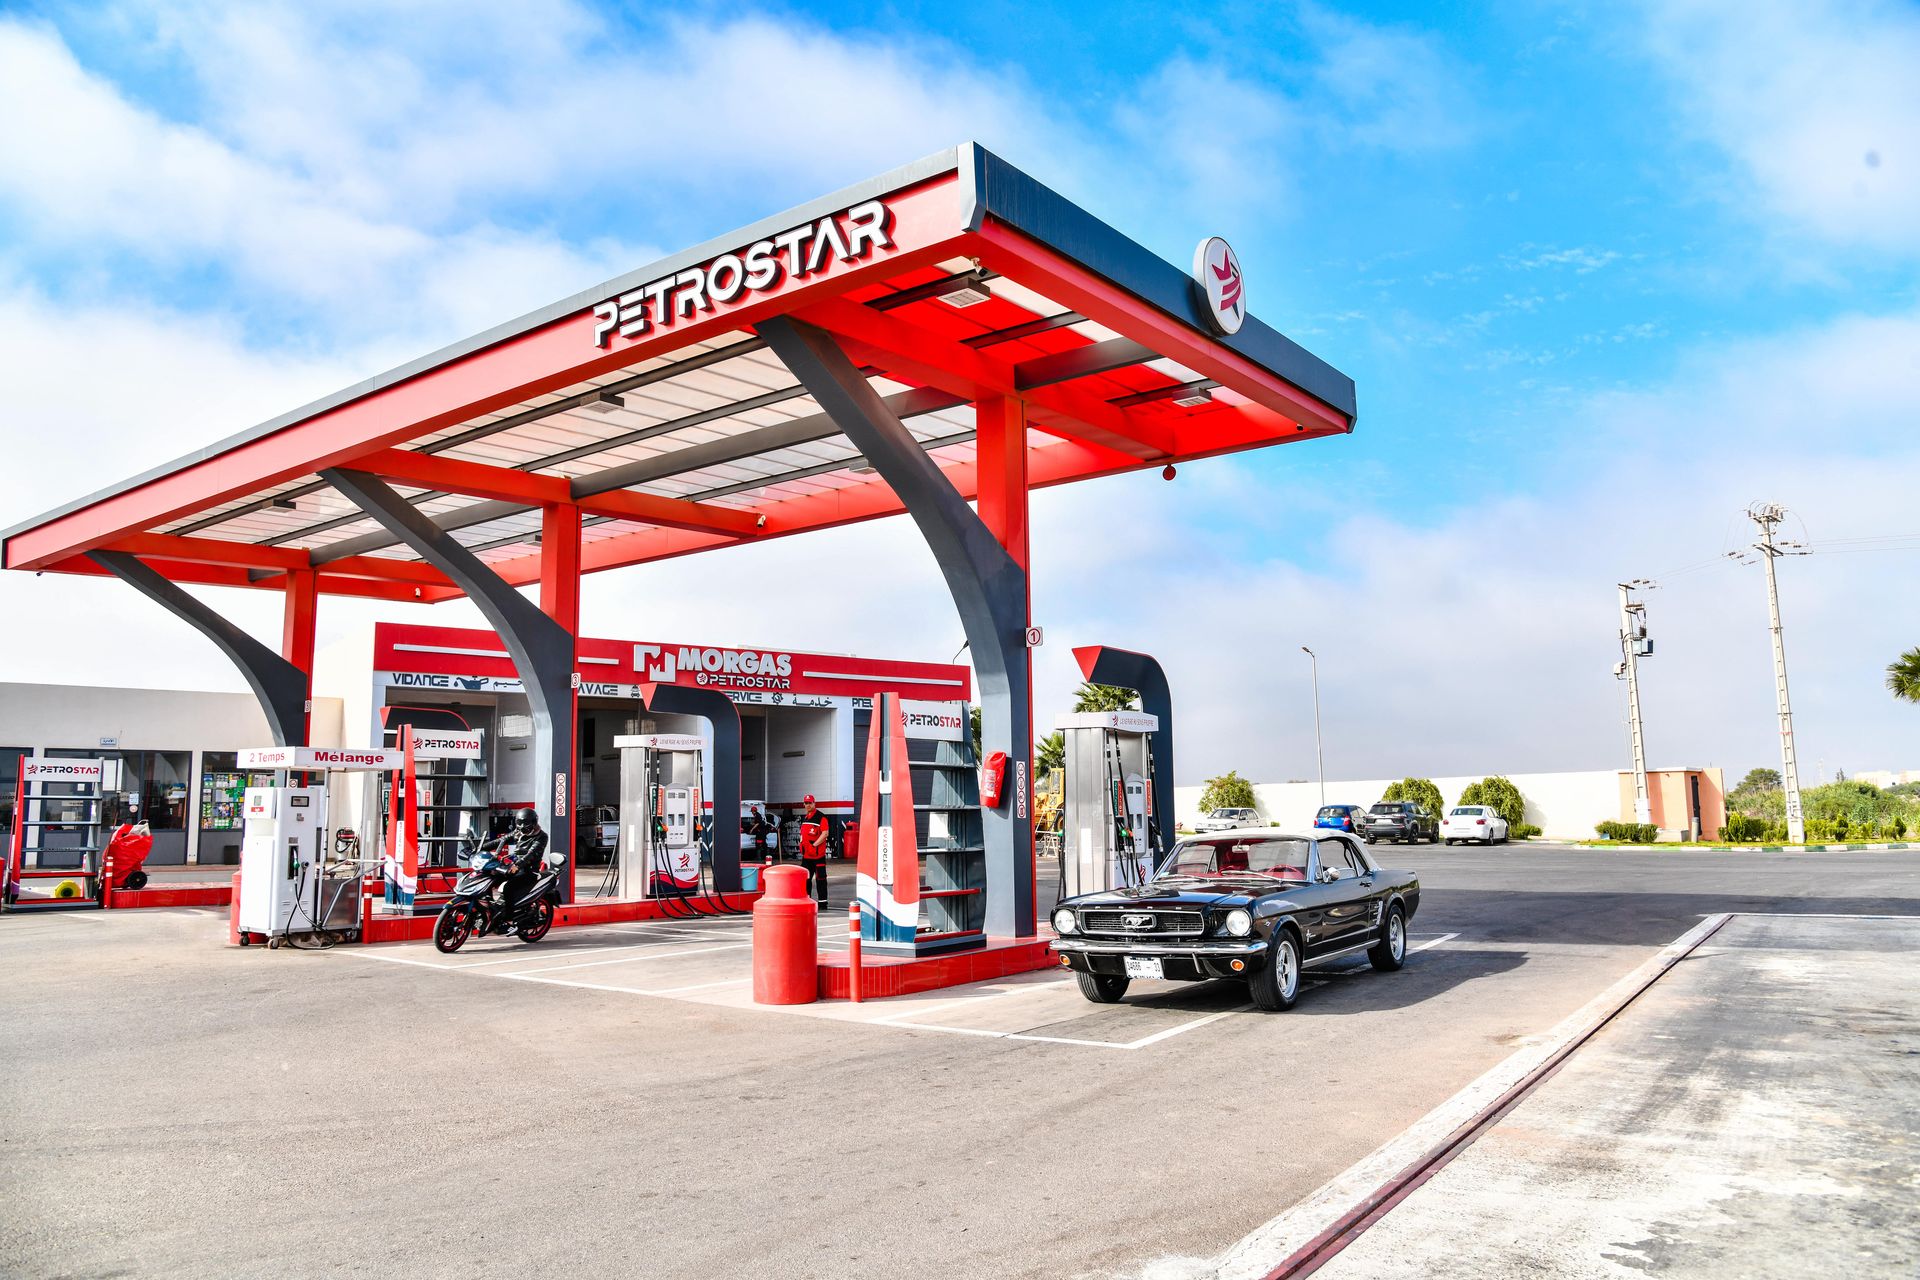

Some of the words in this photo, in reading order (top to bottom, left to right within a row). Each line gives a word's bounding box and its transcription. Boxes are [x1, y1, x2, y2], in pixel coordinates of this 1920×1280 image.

[593, 199, 892, 348] PETROSTAR
[1031, 631, 1036, 642] 1
[677, 647, 793, 677] MORGAS
[392, 672, 449, 687] VIDANGE
[709, 674, 791, 689] PETROSTAR
[577, 683, 618, 696] AVAGE
[723, 691, 762, 703] ERVICE
[792, 692, 833, 707] خدمة
[909, 713, 962, 729] PETROSTAR
[424, 739, 479, 750] PETROSTAR
[249, 752, 255, 763] 2
[258, 751, 285, 763] Temps
[314, 750, 385, 765] Mélange
[40, 765, 99, 775] PETROSTAR
